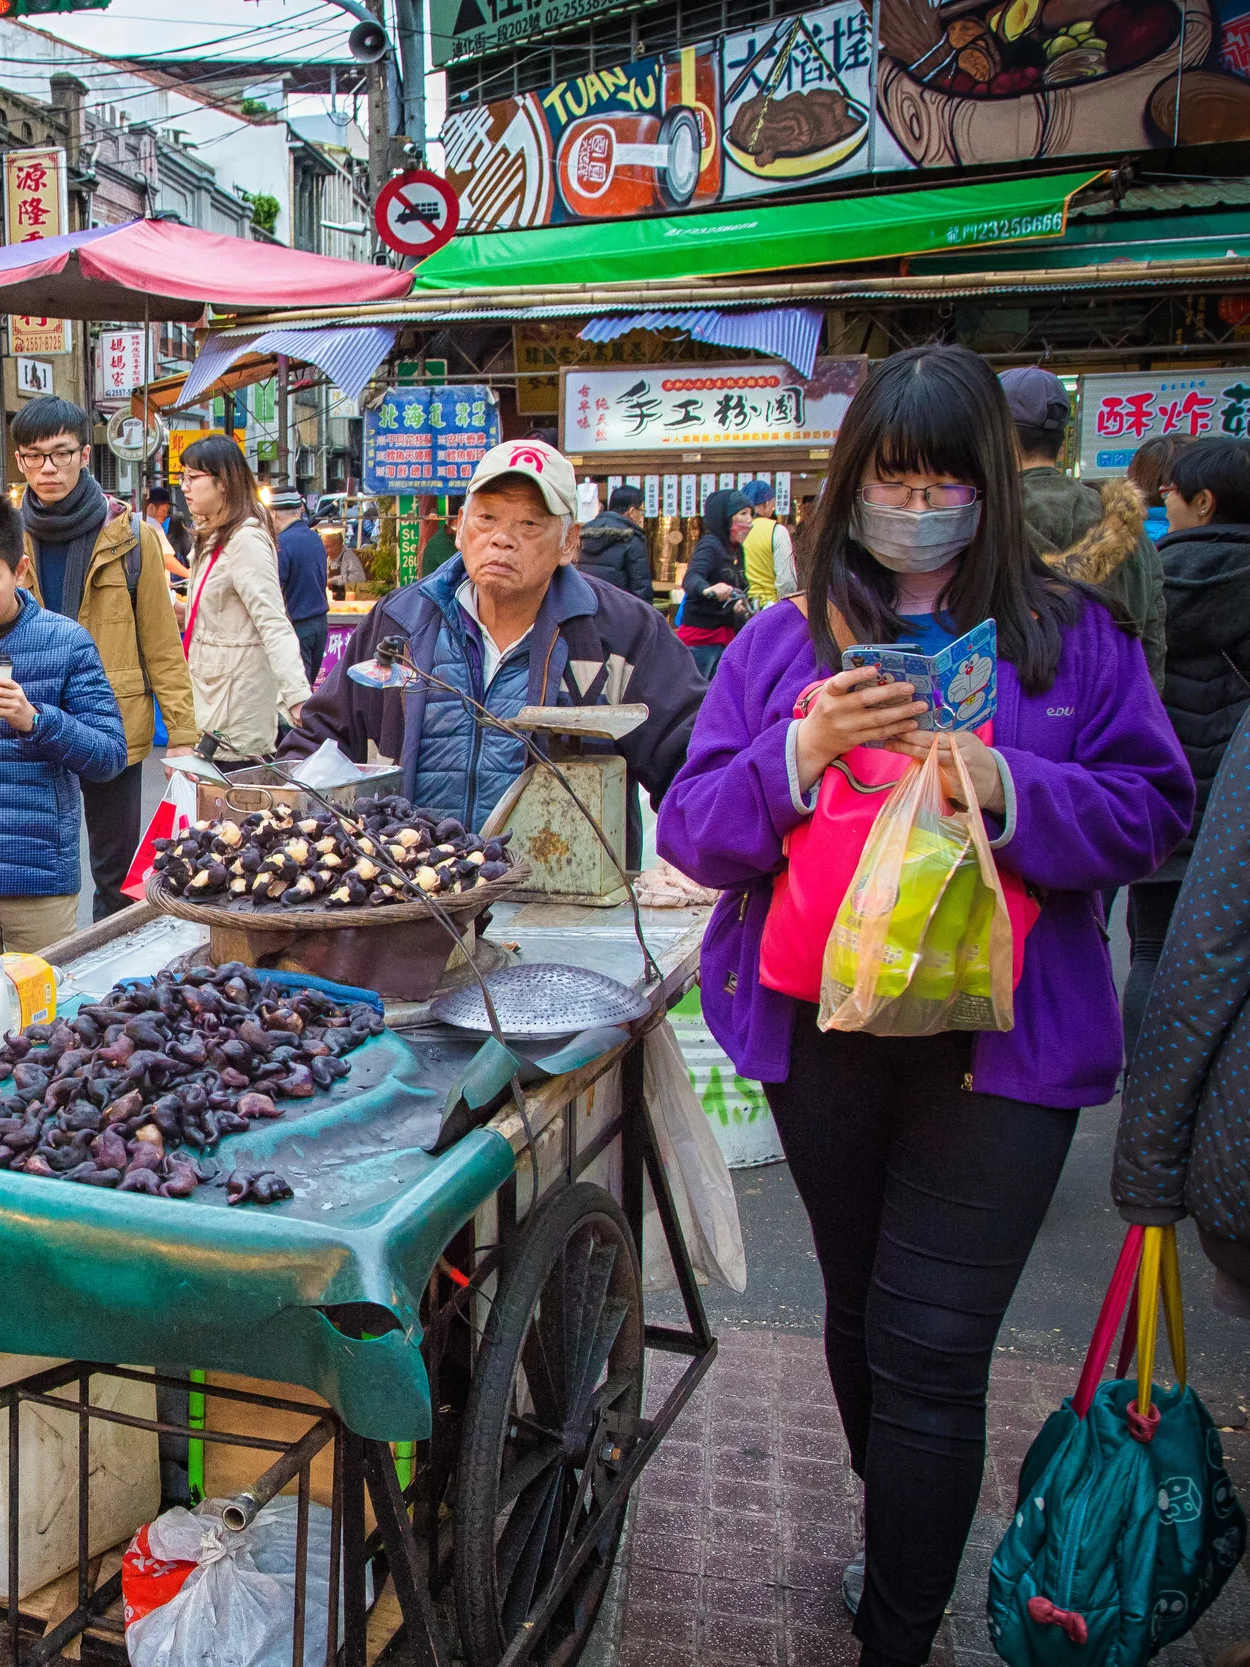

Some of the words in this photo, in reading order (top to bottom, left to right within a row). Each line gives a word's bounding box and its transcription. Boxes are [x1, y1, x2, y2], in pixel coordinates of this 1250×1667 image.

[727, 9, 871, 104] 大稻埕
[542, 66, 628, 126] TUAN
[378, 402, 447, 429] 北海道
[615, 379, 806, 437] 手工粉圓
[402, 528, 418, 540] St.
[402, 542, 418, 553] Se
